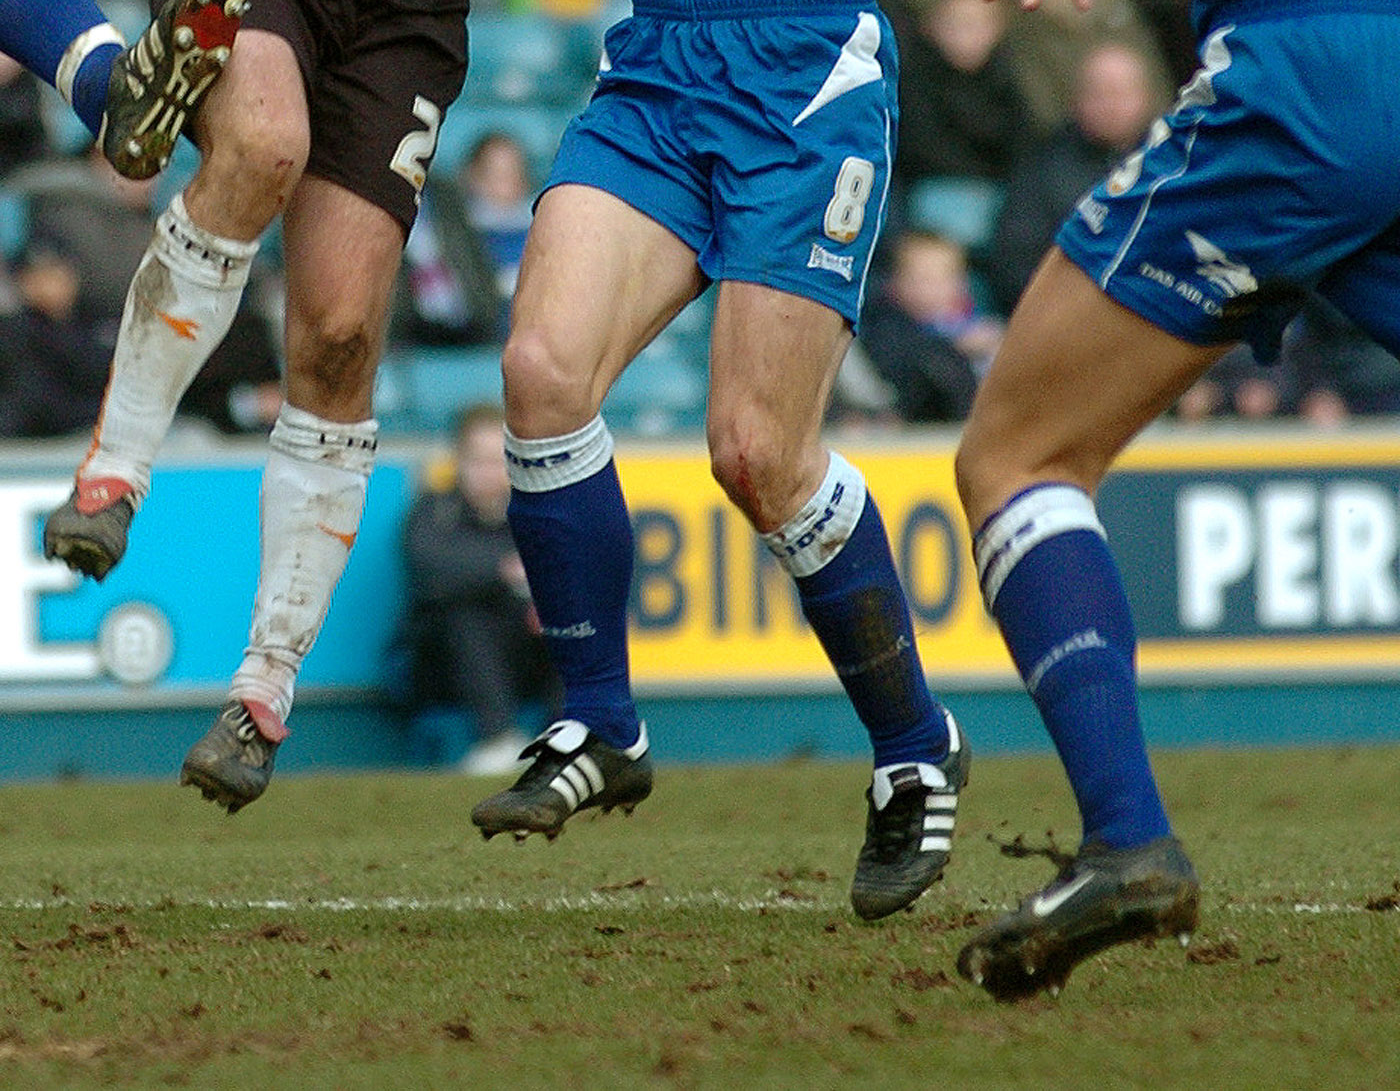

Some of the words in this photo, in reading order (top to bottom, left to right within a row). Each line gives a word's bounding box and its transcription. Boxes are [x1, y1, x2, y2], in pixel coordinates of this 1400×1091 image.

[389, 94, 441, 191] 2
[824, 157, 875, 244] 8
[627, 500, 962, 632] BINO
[774, 481, 846, 558] IONS
[1176, 480, 1400, 630] PER
